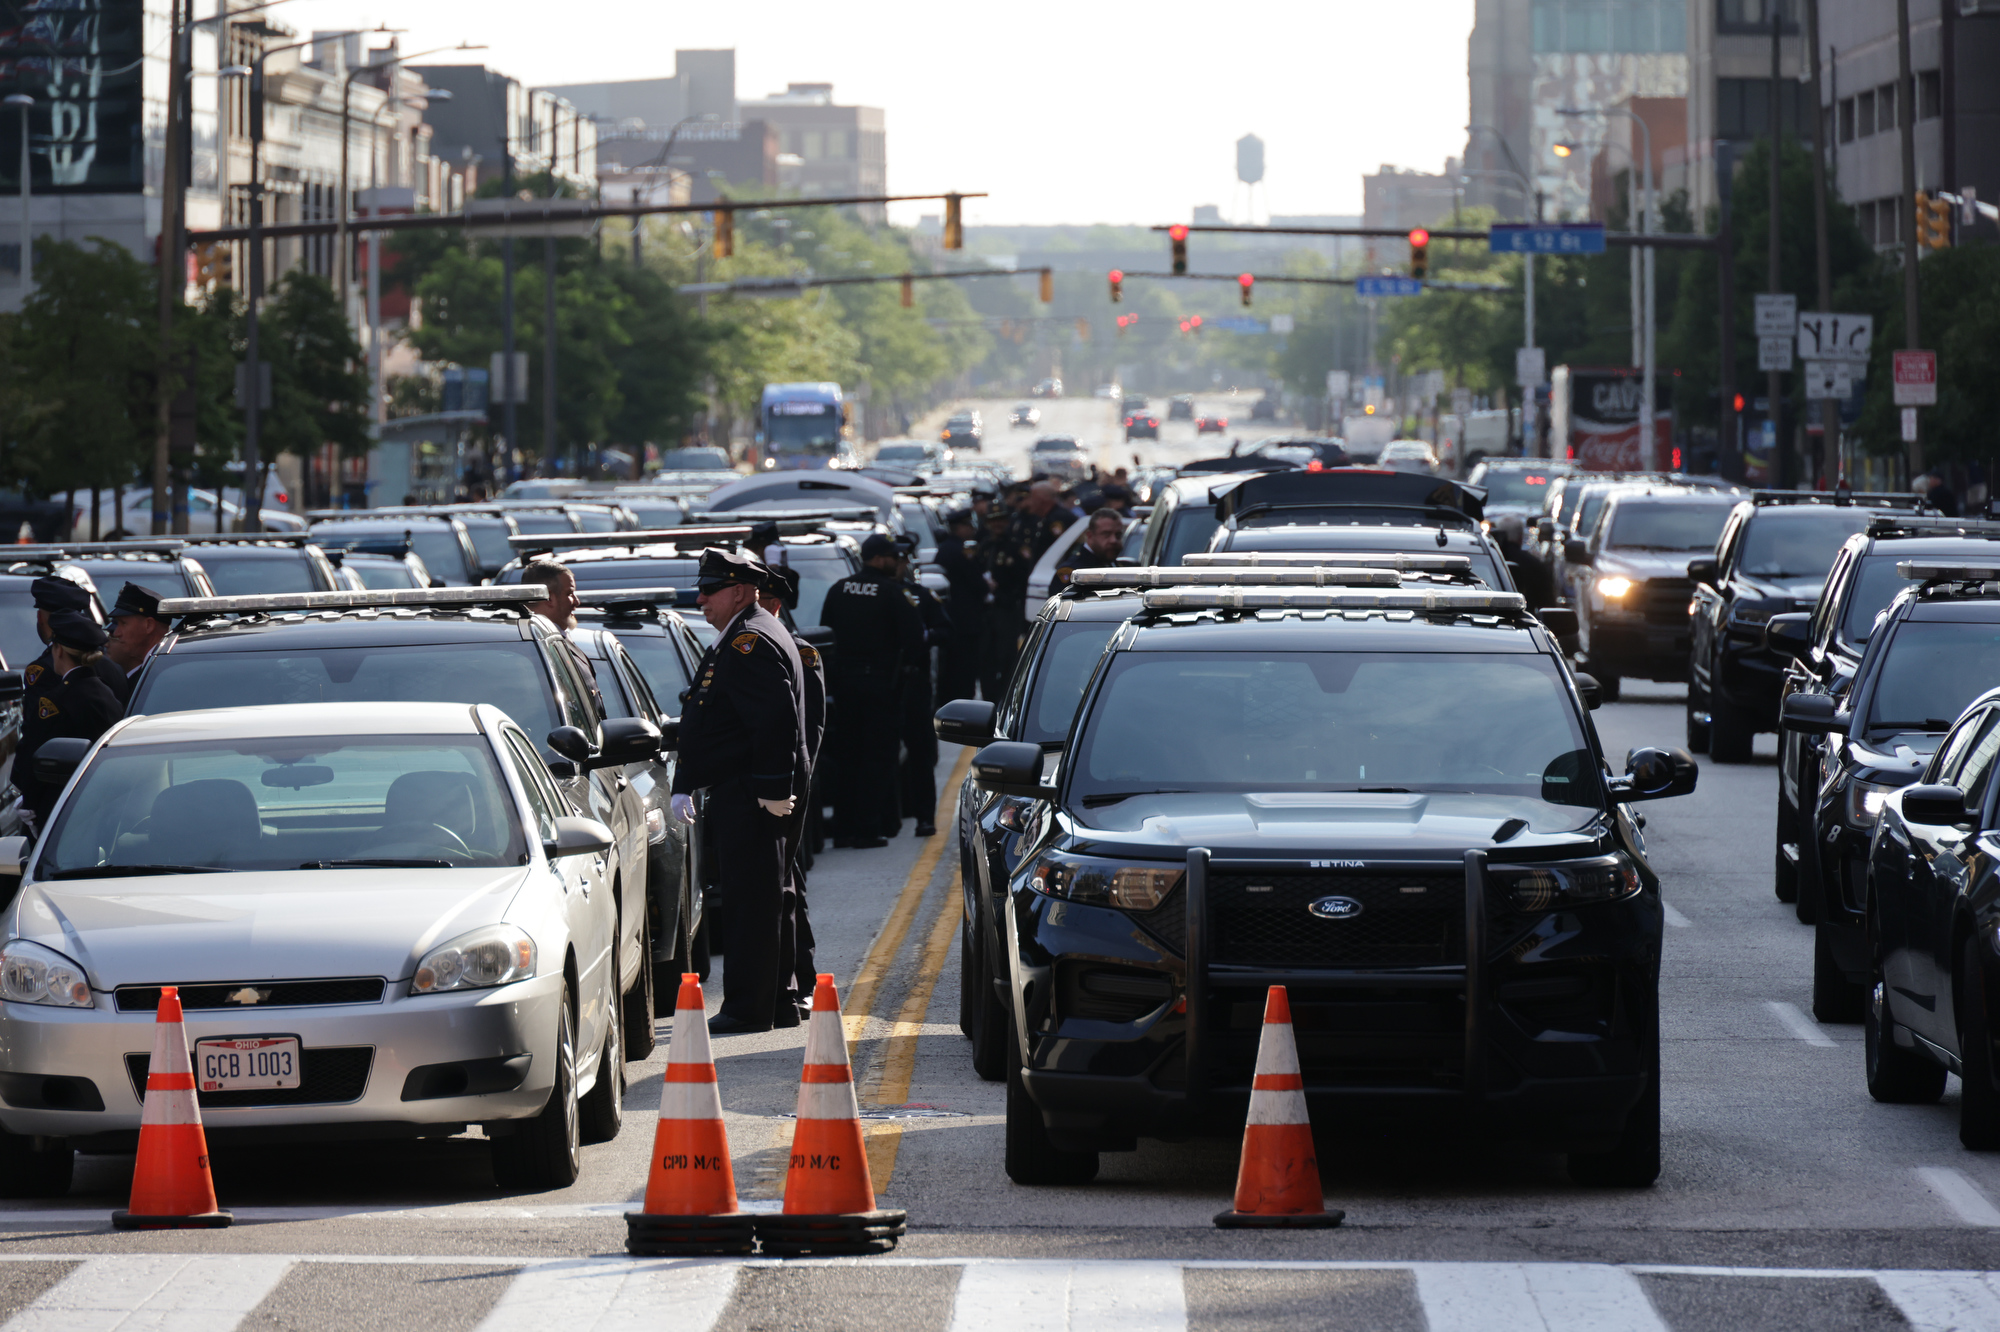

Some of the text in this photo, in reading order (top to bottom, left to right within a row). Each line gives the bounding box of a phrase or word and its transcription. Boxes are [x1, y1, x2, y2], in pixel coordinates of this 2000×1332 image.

[843, 581, 879, 596] POLICE
[1827, 824, 1842, 843] 8
[1310, 860, 1365, 868] SETINA
[1321, 900, 1352, 914] Ford
[235, 1041, 260, 1050] OHIO
[206, 1051, 292, 1078] GCB 1003
[663, 1154, 720, 1171] CPD M/C
[789, 1154, 840, 1171] CPD M/C
